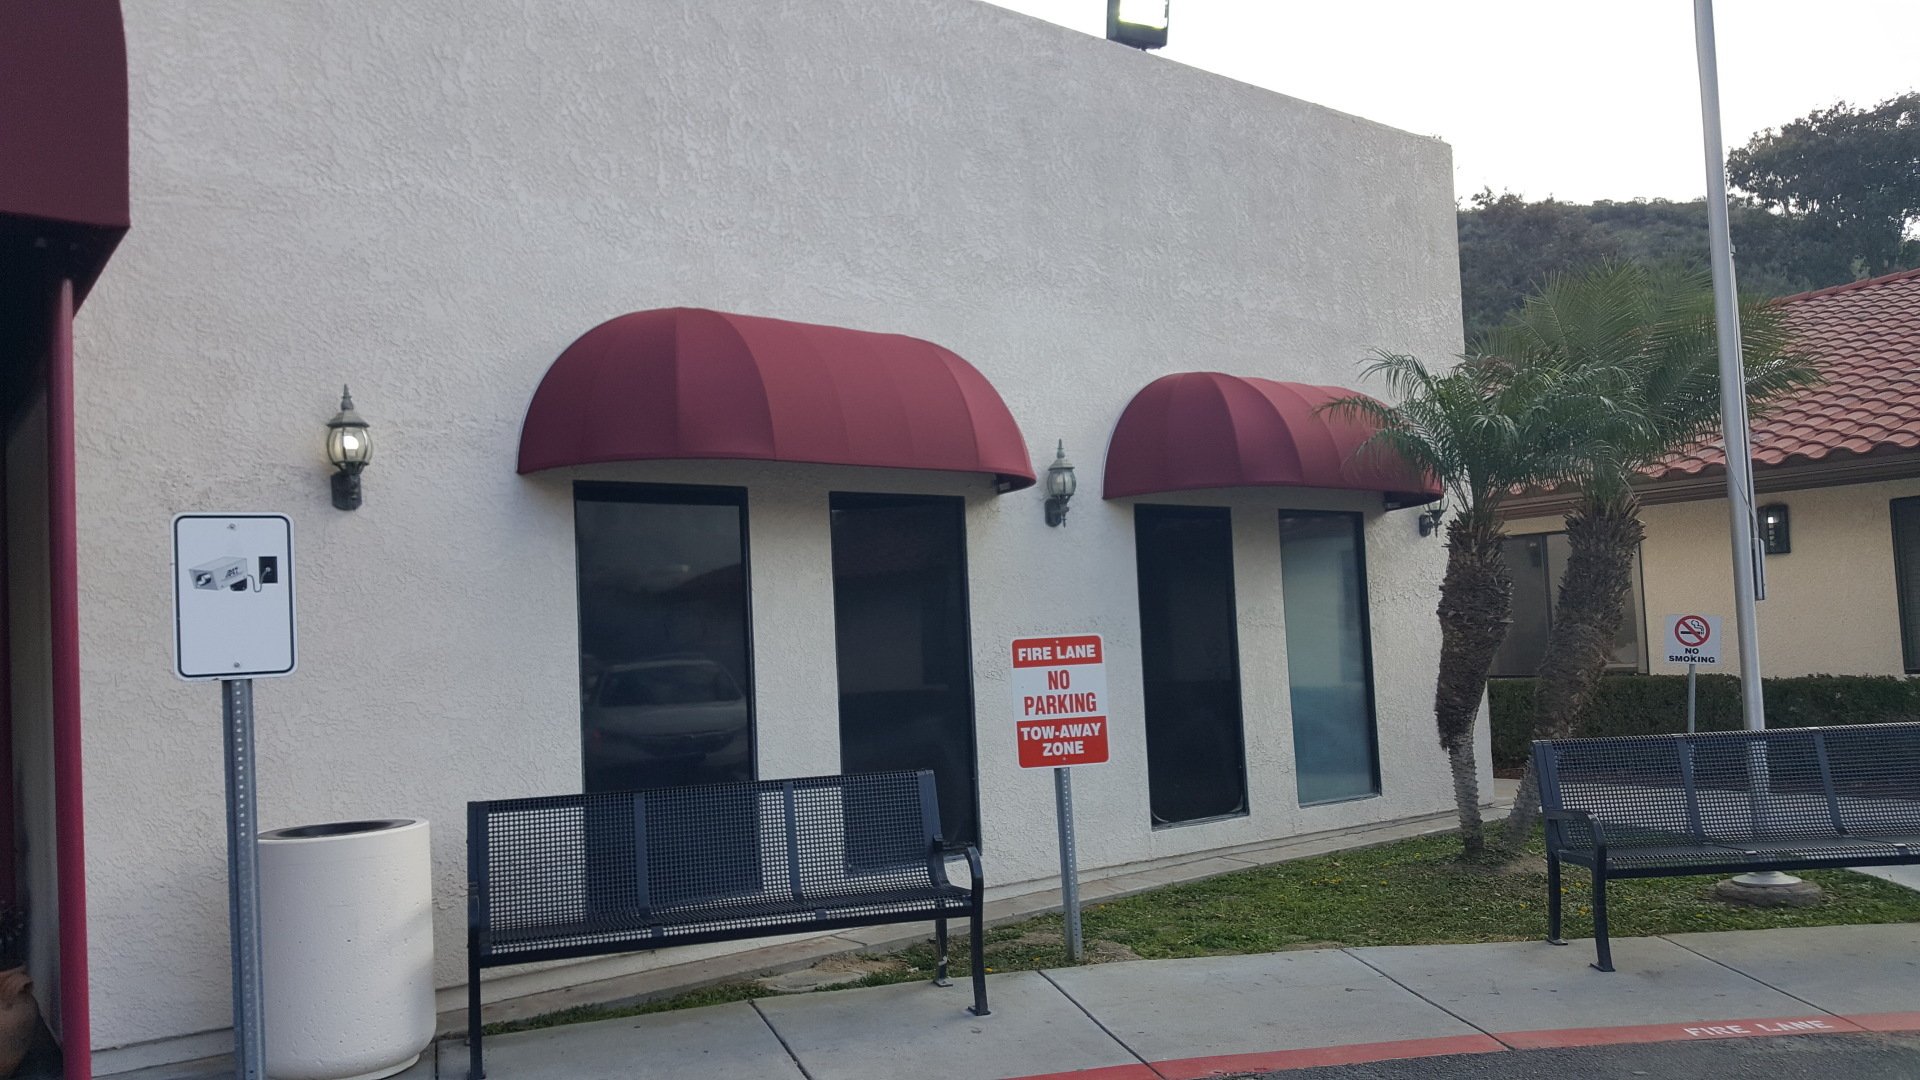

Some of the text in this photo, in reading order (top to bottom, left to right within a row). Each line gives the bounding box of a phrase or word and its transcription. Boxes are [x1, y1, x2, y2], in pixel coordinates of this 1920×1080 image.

[1018, 645, 1096, 661] FIRE LANE
[1669, 655, 1715, 663] SMOKING
[1048, 670, 1070, 690] NO
[1024, 692, 1097, 716] PARKING
[1021, 723, 1101, 740] TOW-AWAY
[1043, 741, 1085, 756] ZONE
[1684, 1020, 1833, 1037] FIRE LANE
